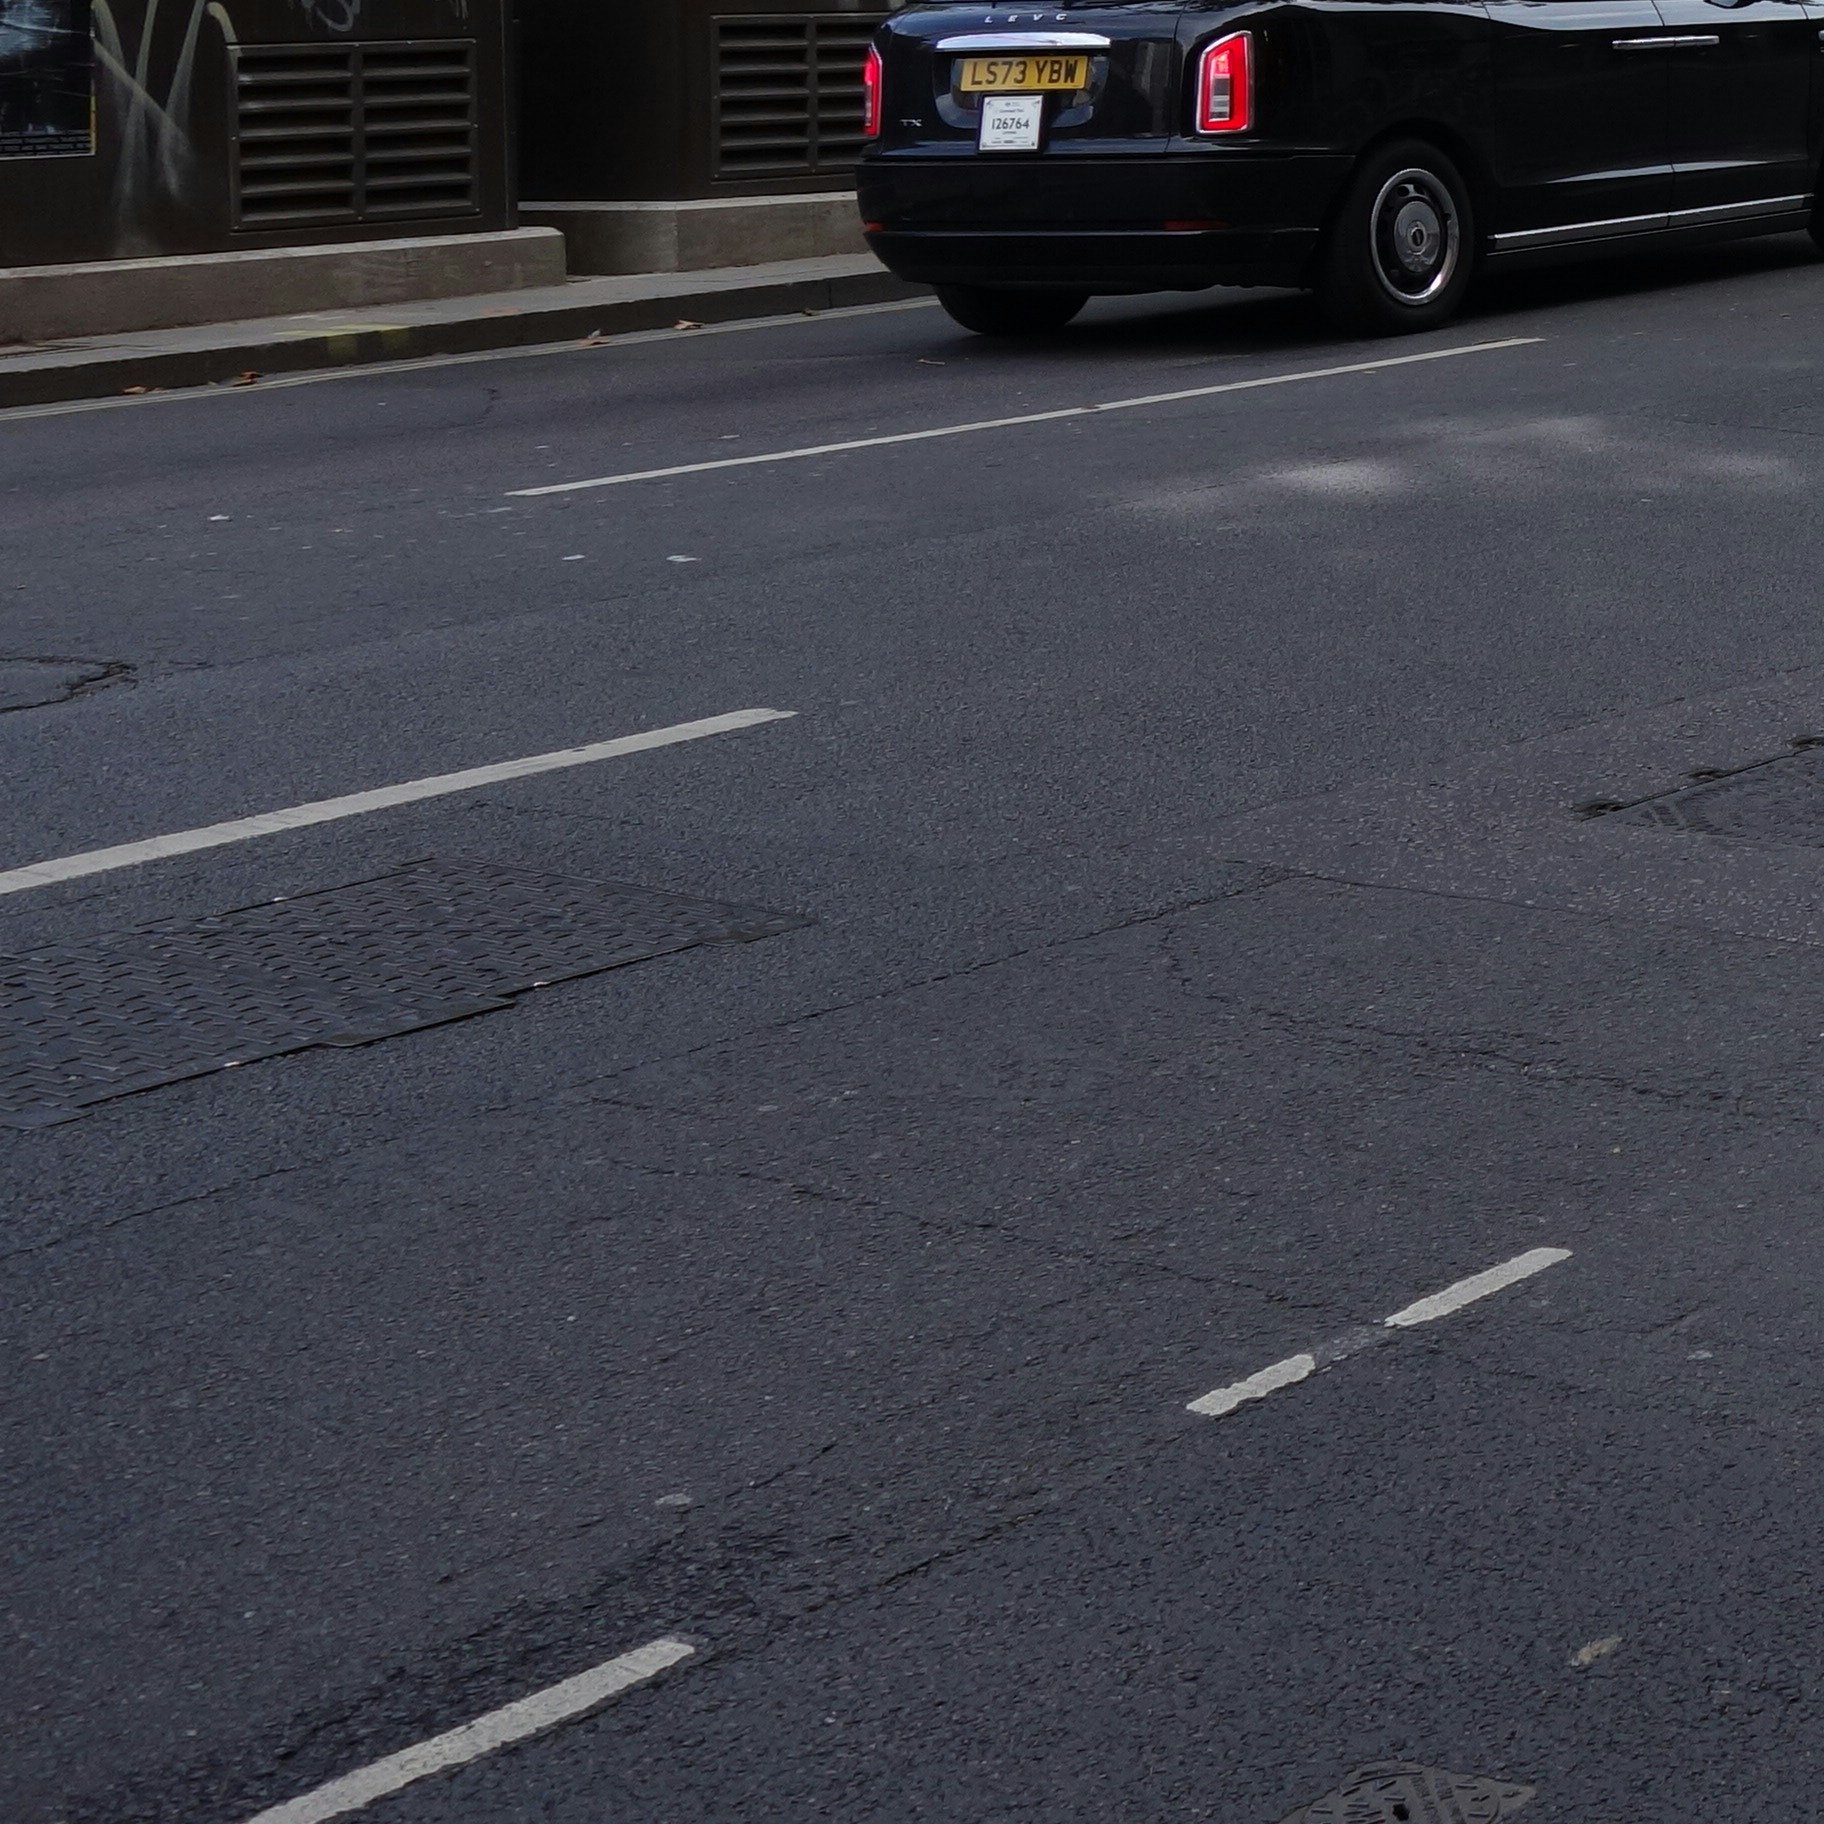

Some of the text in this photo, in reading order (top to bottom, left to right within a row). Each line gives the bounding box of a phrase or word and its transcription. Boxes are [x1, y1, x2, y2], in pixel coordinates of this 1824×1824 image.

[984, 13, 1068, 24] LEVC
[970, 59, 1079, 86] LS73 YBW
[900, 118, 923, 127] TX
[991, 117, 1030, 130] 126764
